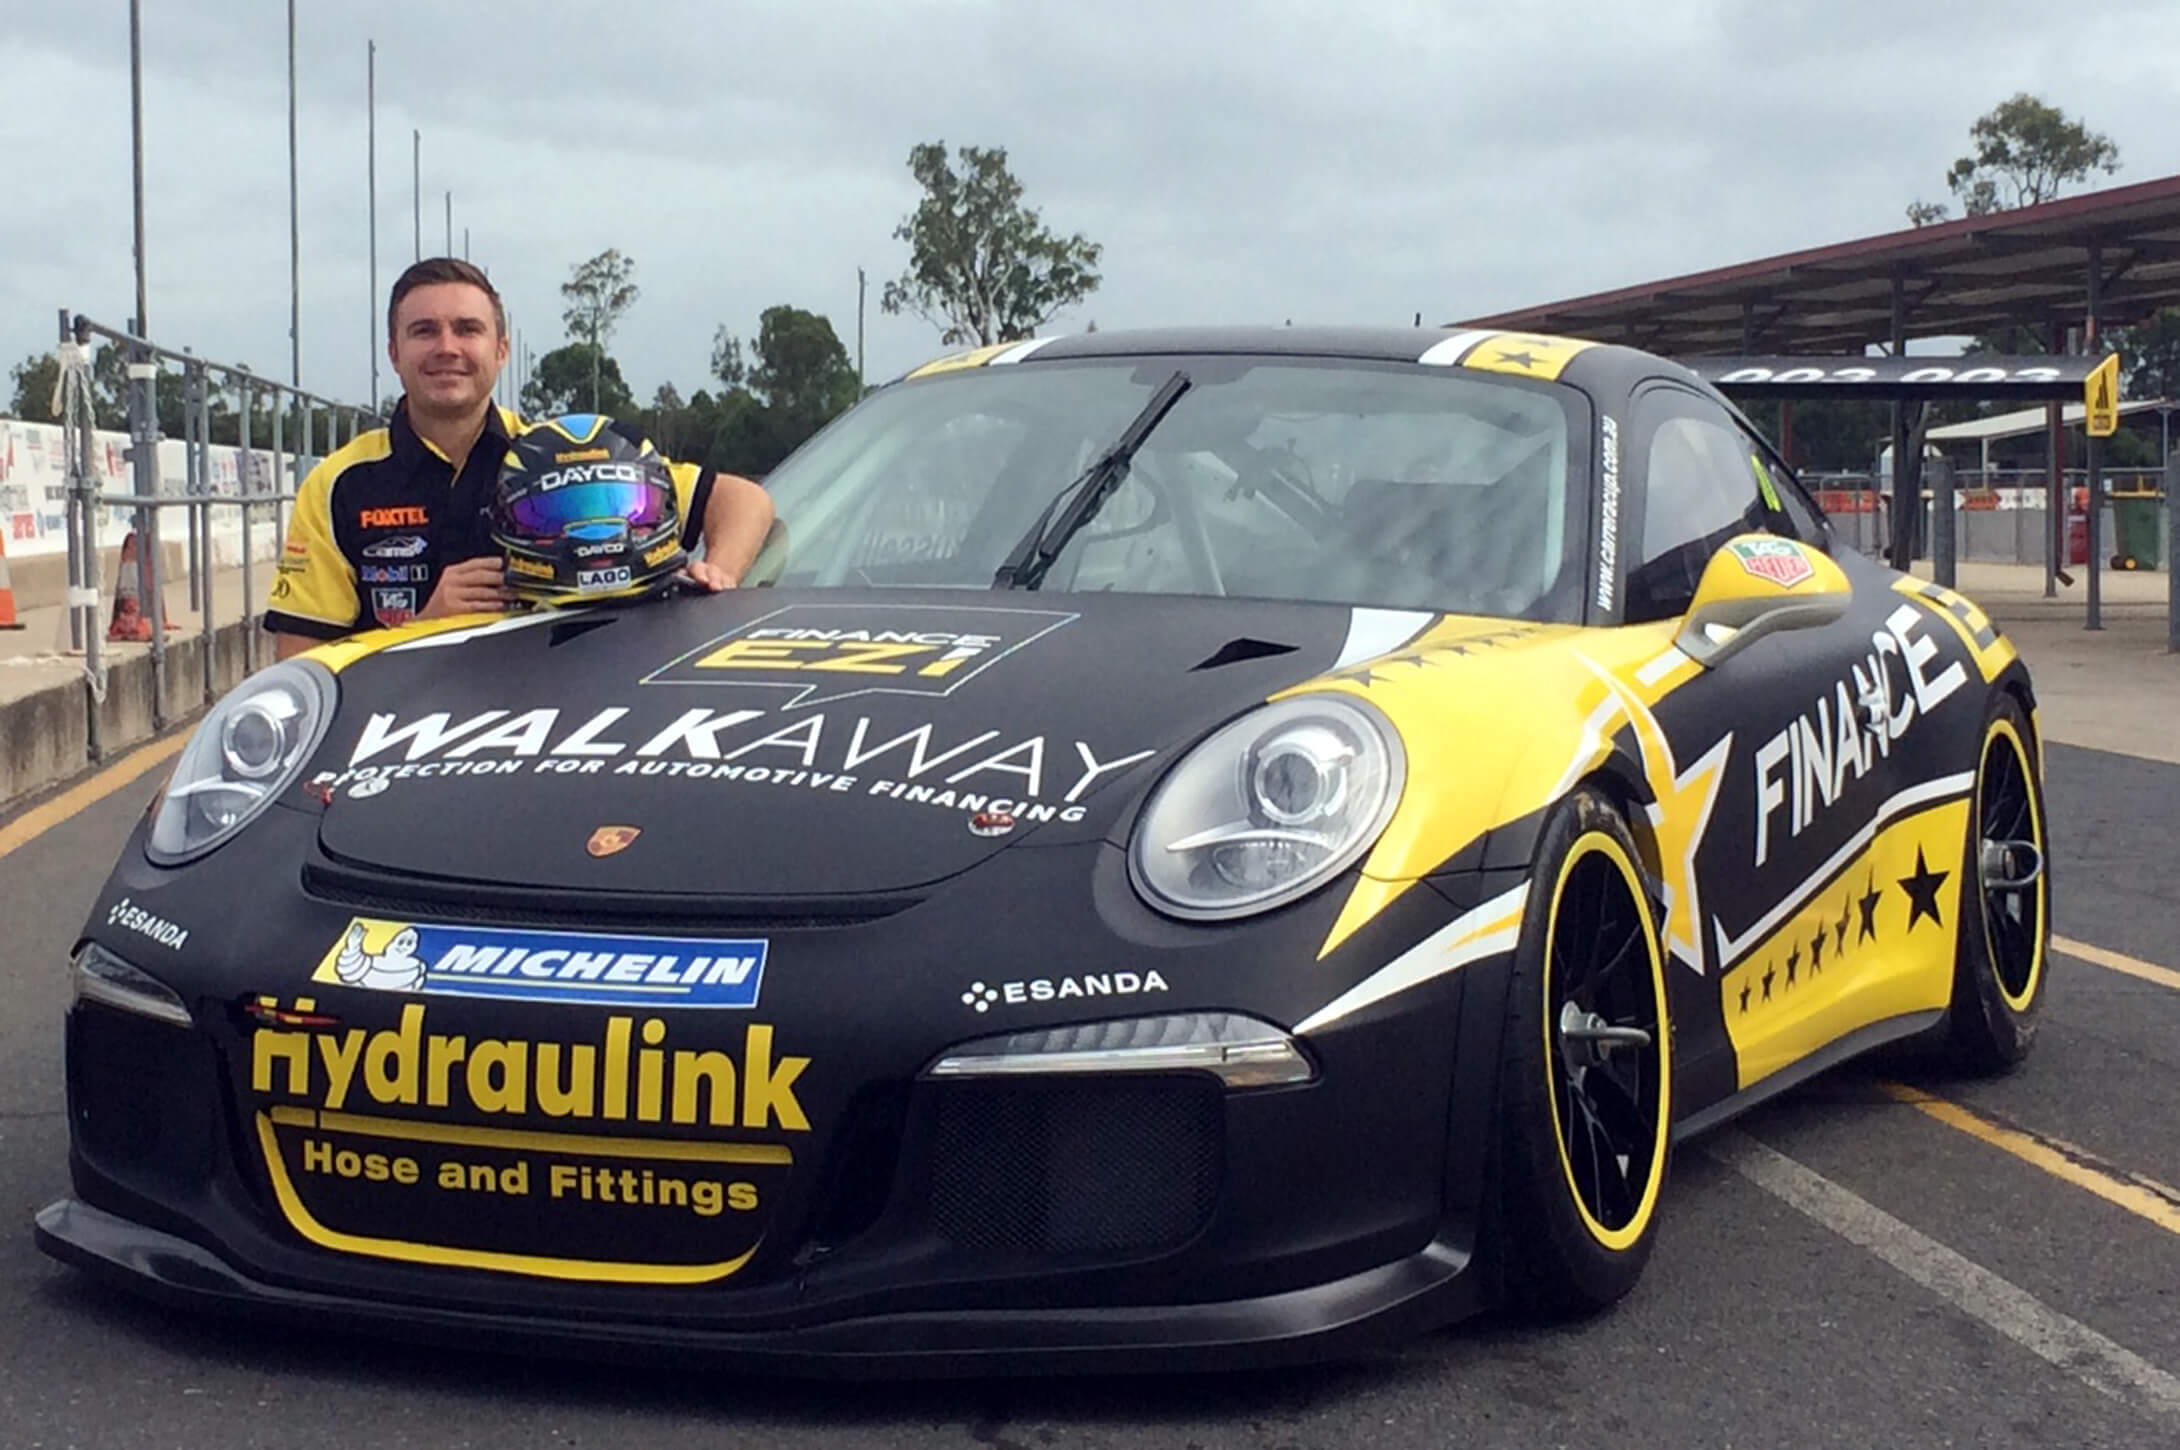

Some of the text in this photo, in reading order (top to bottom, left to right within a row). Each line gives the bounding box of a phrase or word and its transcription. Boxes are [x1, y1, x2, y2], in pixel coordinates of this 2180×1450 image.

[541, 464, 638, 491] DAYCO
[361, 506, 429, 528] FOXTEL
[362, 565, 409, 581] Mobil
[379, 591, 409, 609] TAG
[747, 629, 1001, 648] FINANCE
[348, 708, 1157, 801] WALKAWAY
[1755, 604, 1969, 867] FINANCE
[312, 758, 1088, 823] PROTECTION FOR AUTOMOTIVE FINANCING
[120, 906, 189, 951] ESANDA
[433, 945, 757, 985] MICHELIN
[1003, 970, 1169, 1004] ESANDA
[252, 997, 812, 1131] Hydraulink
[304, 1139, 759, 1216] Hose and Fittings
